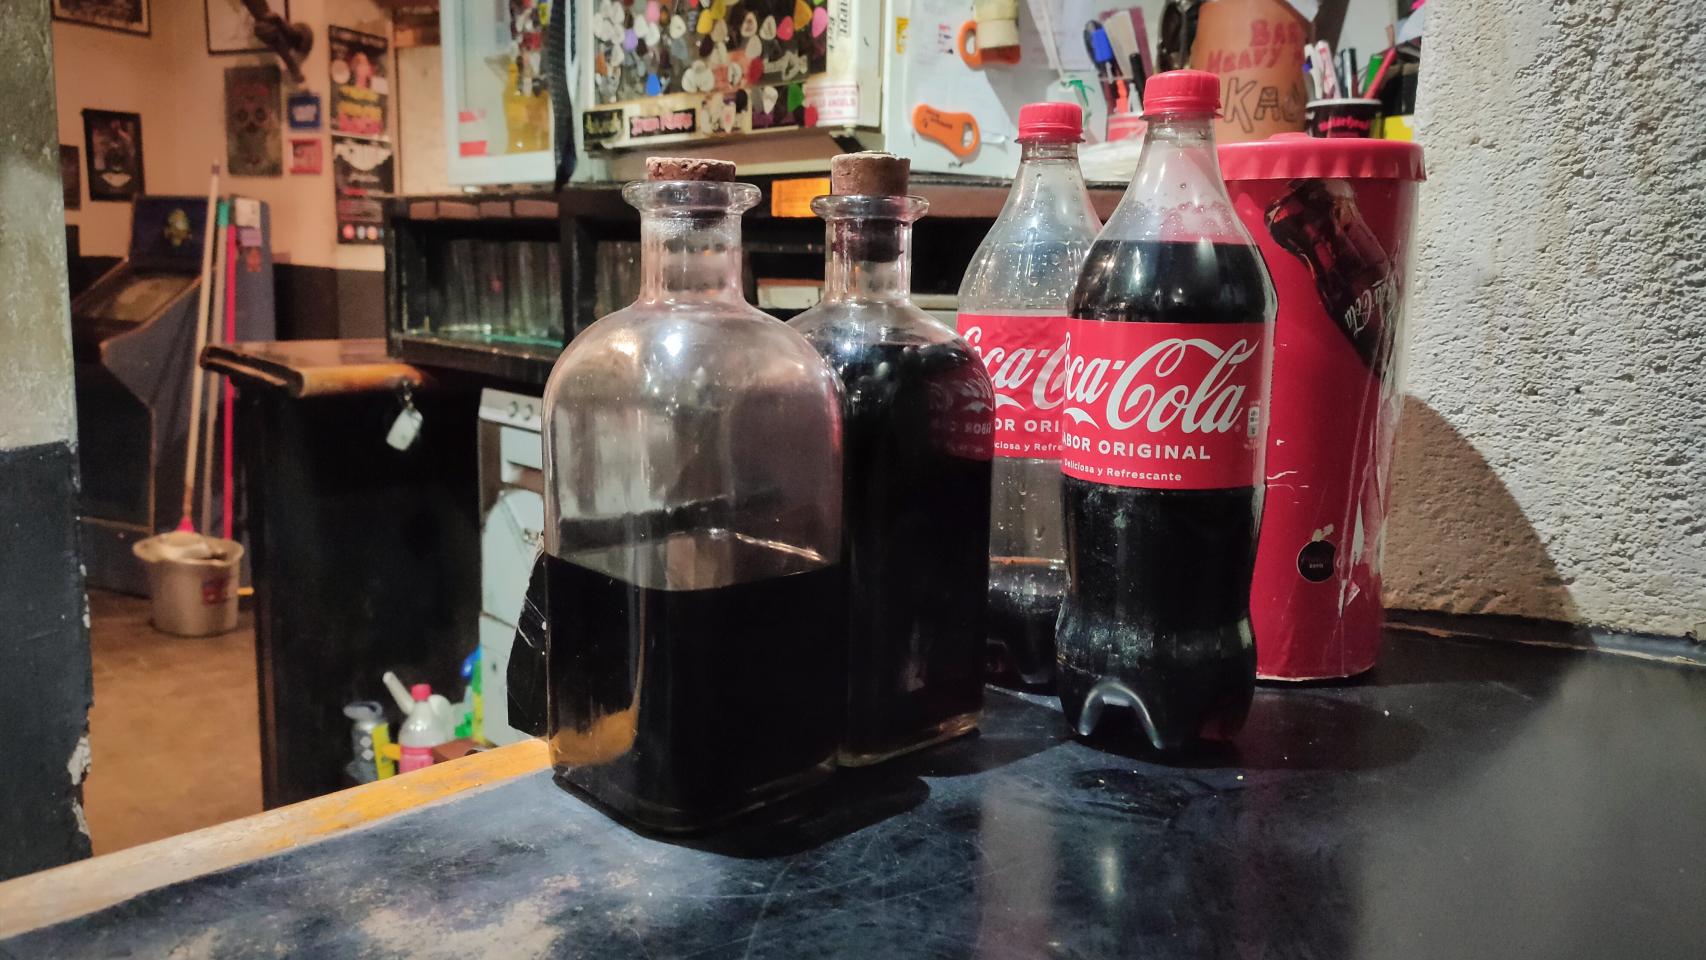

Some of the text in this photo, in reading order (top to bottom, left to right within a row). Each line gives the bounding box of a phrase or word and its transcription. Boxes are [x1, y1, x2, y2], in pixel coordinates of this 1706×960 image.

[1062, 431, 1211, 460] ABOR ORIGINAL
[1097, 467, 1104, 476] y
[1106, 467, 1182, 481] Refrescante
